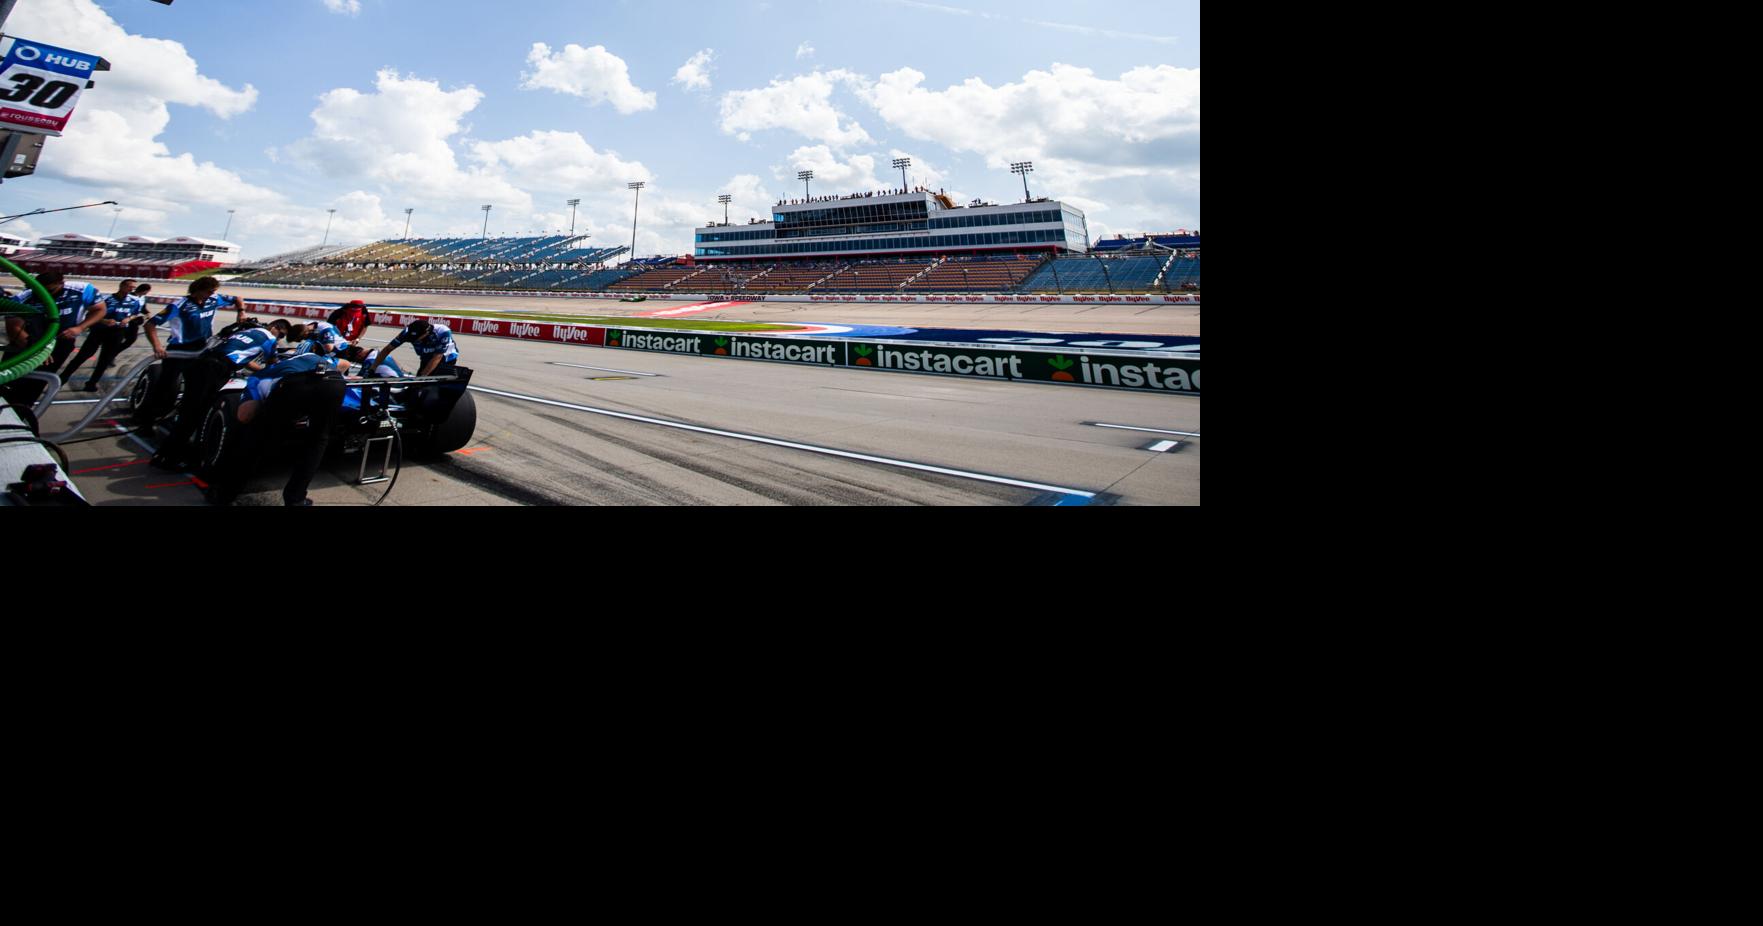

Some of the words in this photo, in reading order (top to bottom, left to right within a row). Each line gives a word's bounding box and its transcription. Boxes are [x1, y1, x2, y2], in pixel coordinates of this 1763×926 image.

[44, 53, 92, 71] HUB
[0, 73, 79, 109] 30
[59, 307, 73, 316] UB
[472, 320, 499, 334] HyVee
[510, 322, 541, 337] HyVee
[553, 325, 588, 341] HyVee
[622, 331, 701, 353] instacart
[731, 337, 836, 364] instacart
[877, 344, 1023, 378] instacart
